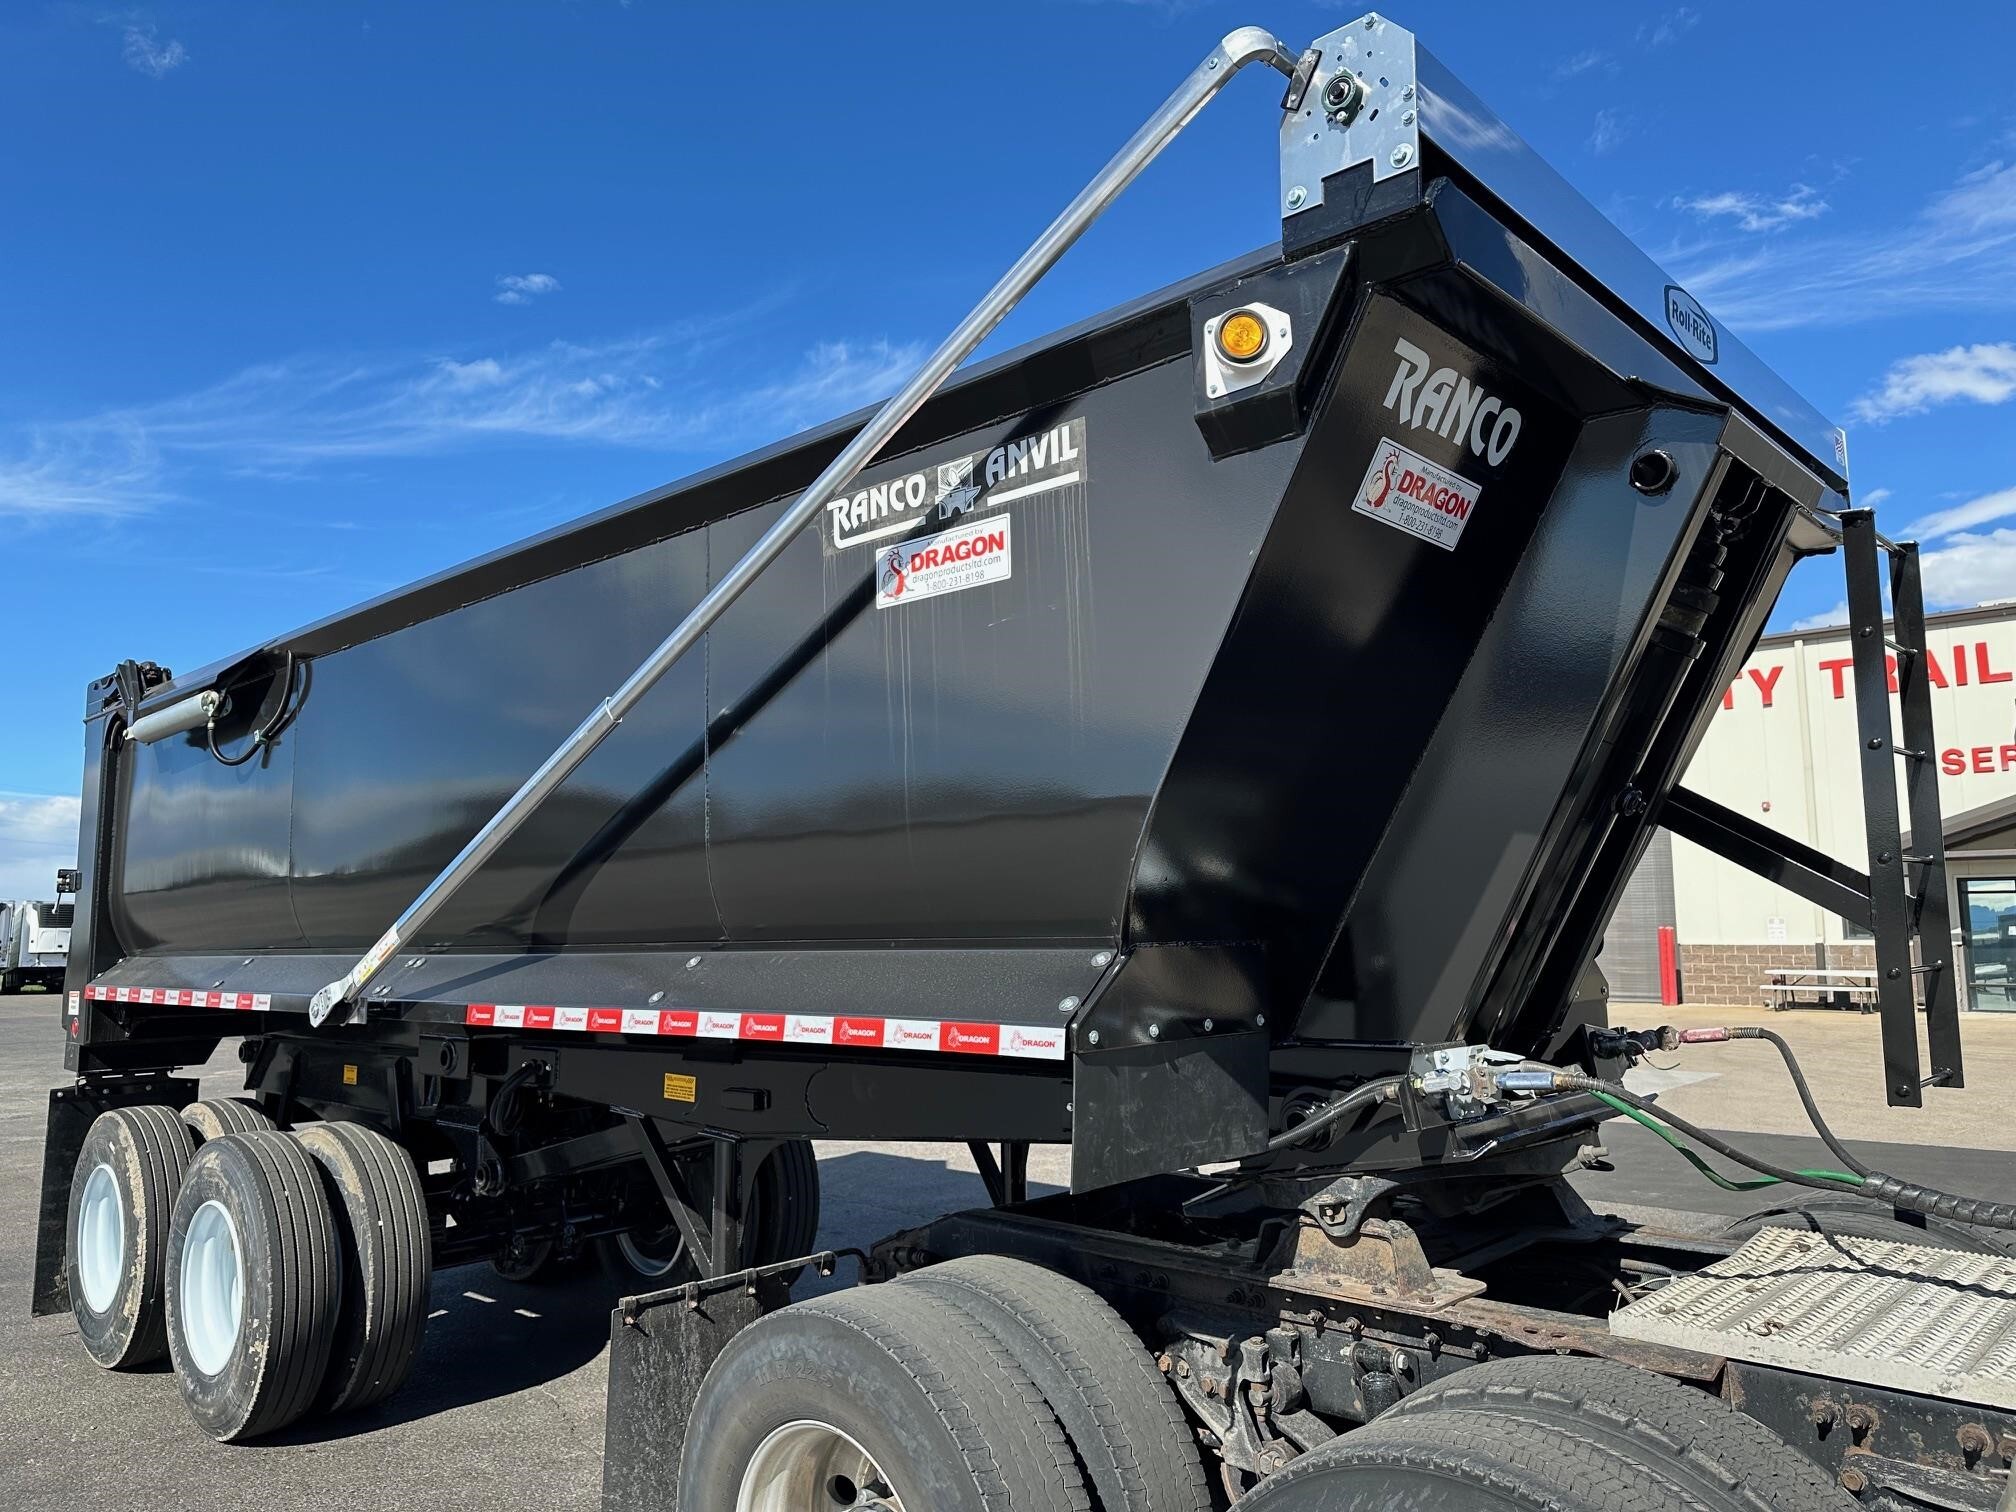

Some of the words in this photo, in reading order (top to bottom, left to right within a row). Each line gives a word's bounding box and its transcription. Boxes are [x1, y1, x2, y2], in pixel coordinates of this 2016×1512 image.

[1383, 336, 1522, 467] RANCO
[827, 473, 926, 541] RANCO
[985, 425, 1079, 487] ANVIL
[1397, 469, 1471, 521] DRAGON
[910, 530, 1004, 573] DRAGON
[912, 555, 1001, 584] dragonproductsltd.com
[926, 570, 985, 592] 1-800-231-8198
[712, 1022, 734, 1030] DRAGON
[753, 1024, 778, 1032] DRAGON
[801, 1026, 827, 1034] DRAGON
[848, 1028, 876, 1037] DRAGON
[903, 1032, 933, 1040] DRAGON
[958, 1035, 990, 1044] DRAGON
[1022, 1039, 1056, 1048] DRAGON
